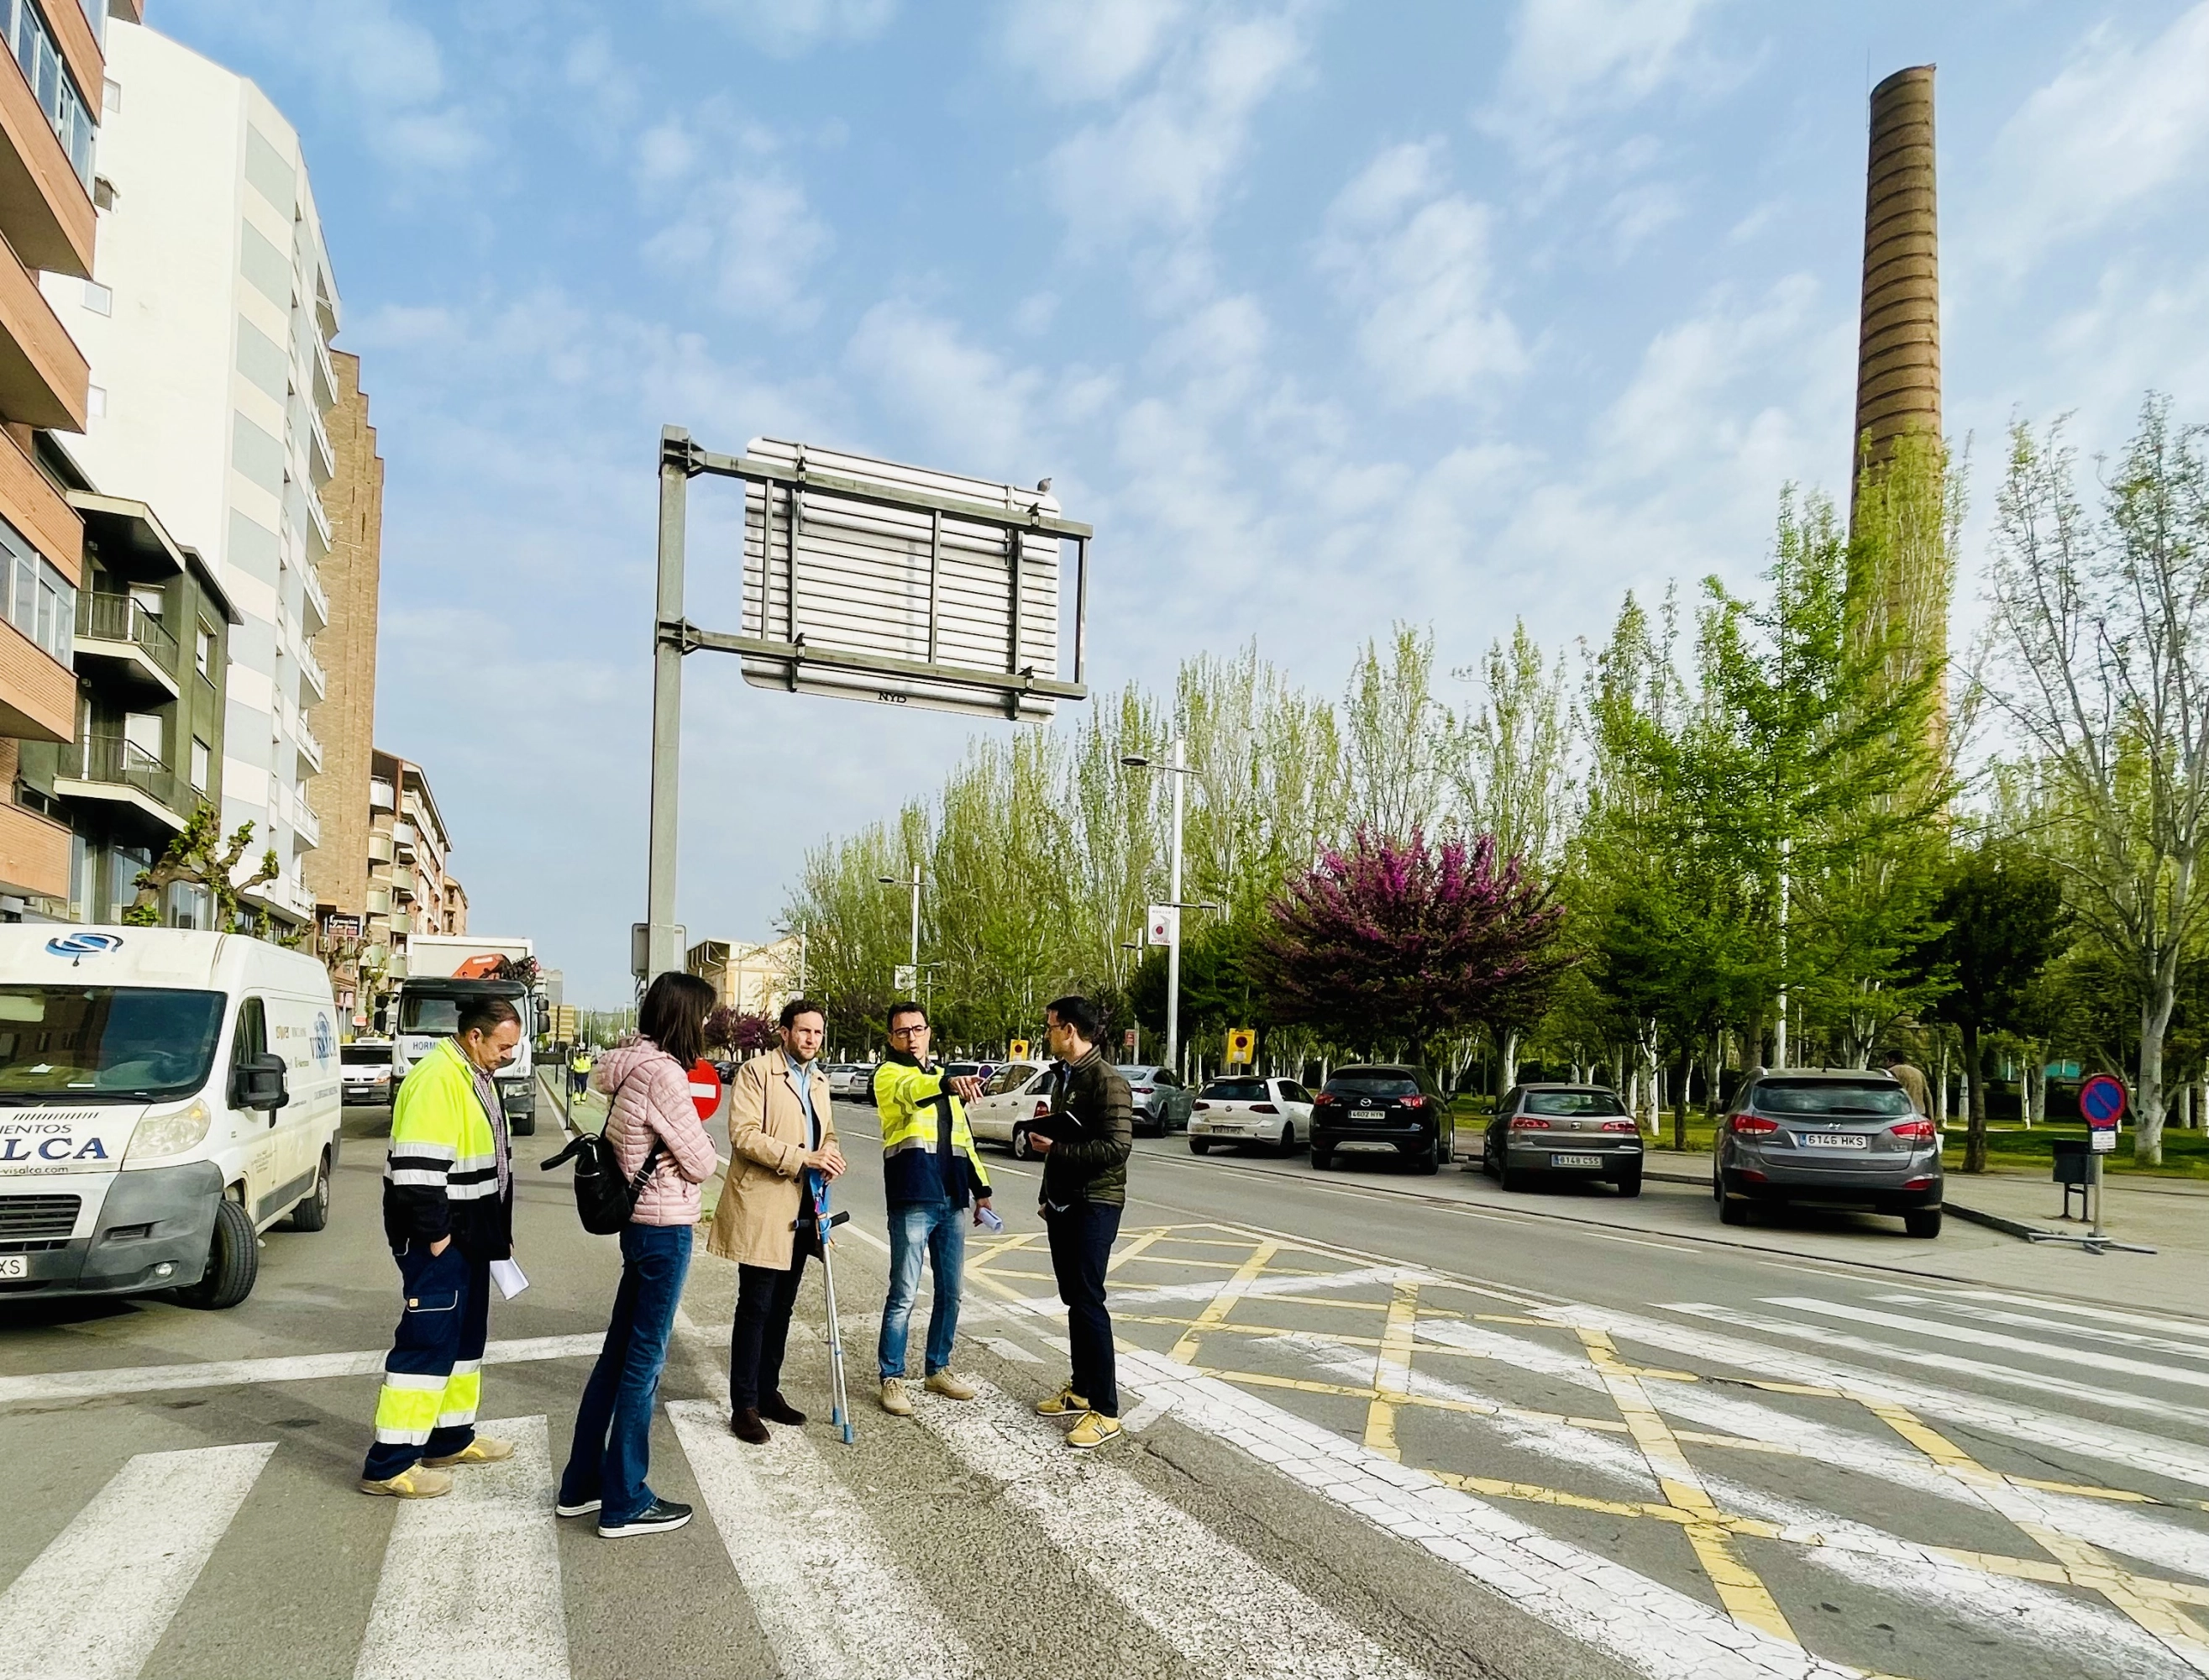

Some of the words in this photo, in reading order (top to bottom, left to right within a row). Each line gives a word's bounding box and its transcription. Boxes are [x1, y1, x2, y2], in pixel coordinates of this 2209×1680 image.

[878, 690, 907, 703] NYD
[1808, 1135, 1837, 1145] 6146
[1841, 1136, 1864, 1146] HKS
[0, 1137, 109, 1160] LCA
[1582, 1157, 1599, 1165] CSS
